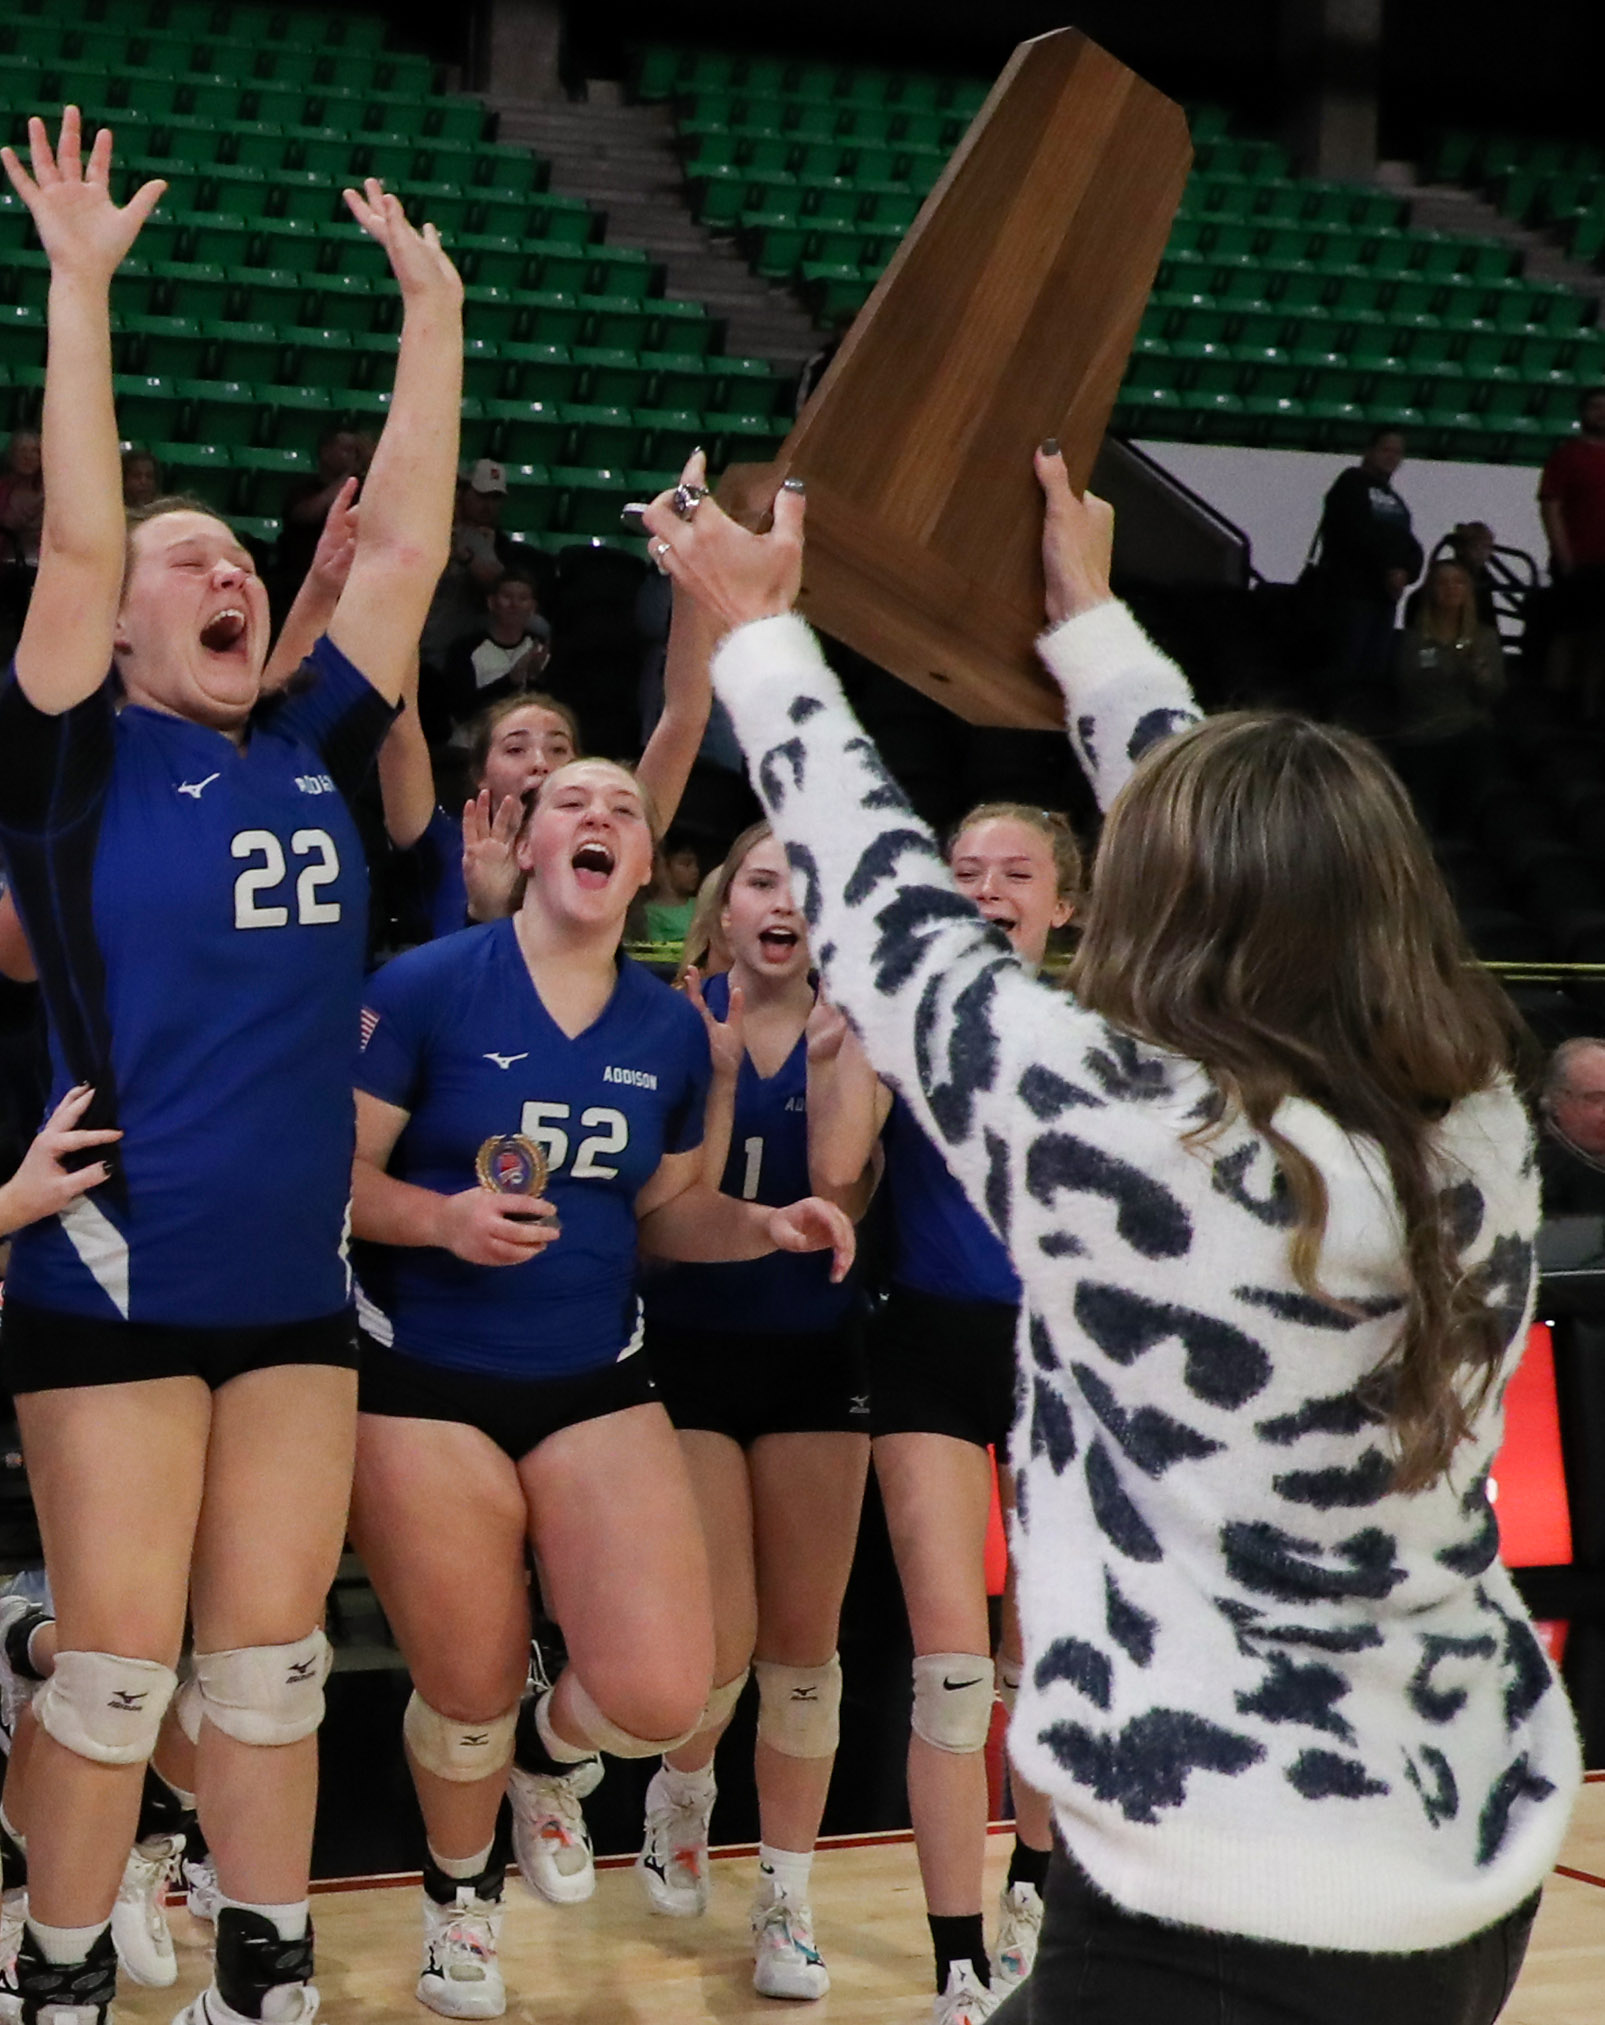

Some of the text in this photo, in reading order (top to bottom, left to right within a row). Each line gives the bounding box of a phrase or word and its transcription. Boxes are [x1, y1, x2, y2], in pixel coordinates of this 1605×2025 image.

[231, 828, 341, 930] 22
[602, 1065, 658, 1091] ADDISON
[520, 1100, 630, 1180] 52
[742, 1136, 763, 1200] 1
